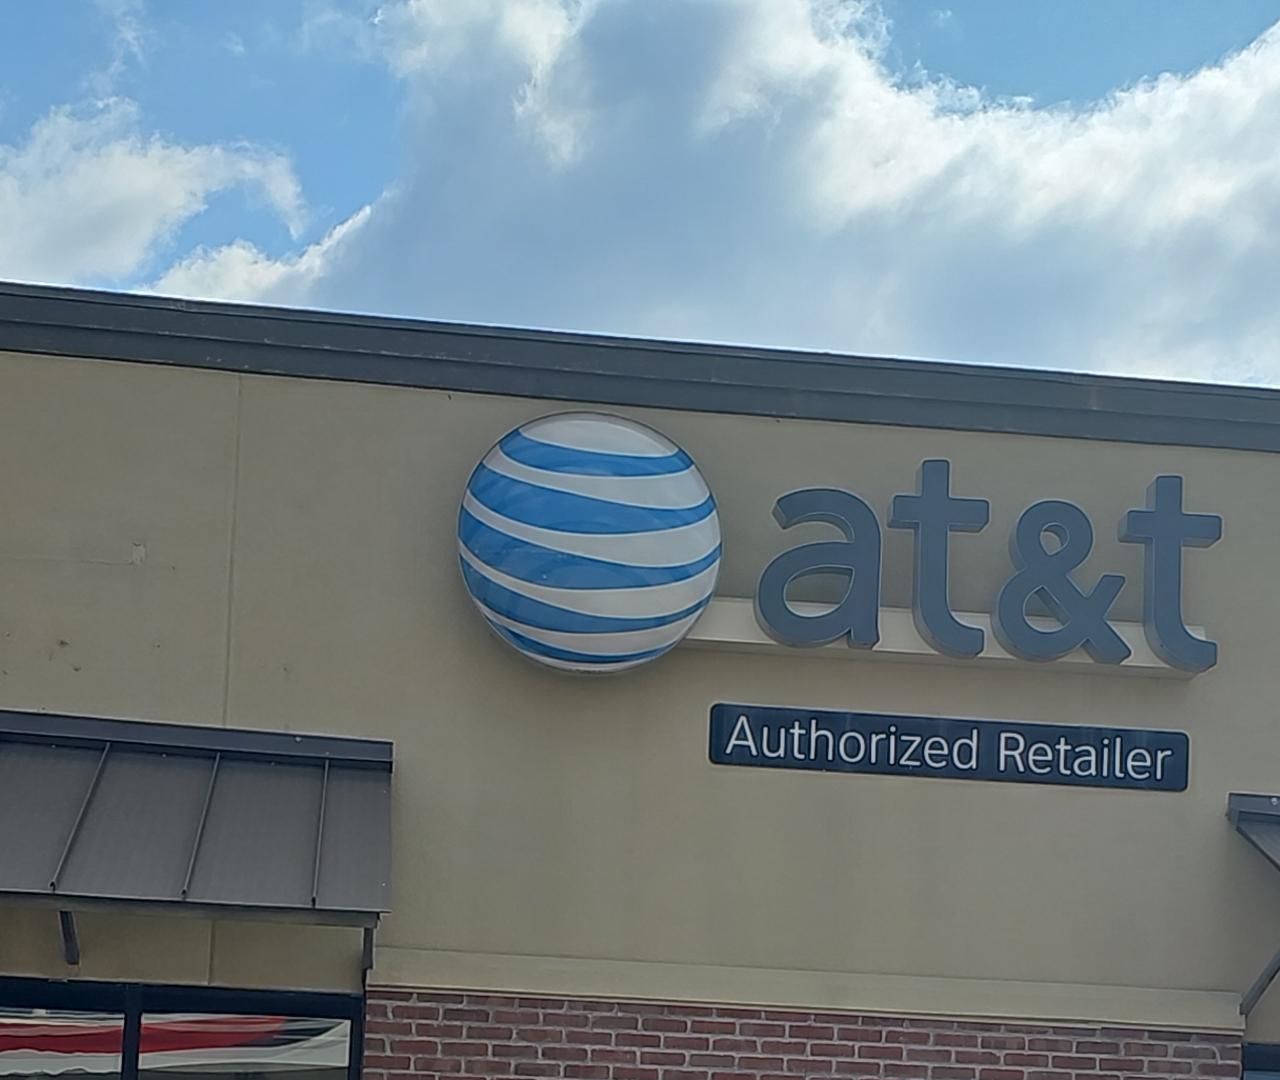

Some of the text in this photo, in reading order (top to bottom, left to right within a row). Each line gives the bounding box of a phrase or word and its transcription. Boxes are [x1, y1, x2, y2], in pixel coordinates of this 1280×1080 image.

[754, 458, 1222, 672] at&t
[725, 715, 1173, 781] Authorized Retailer
